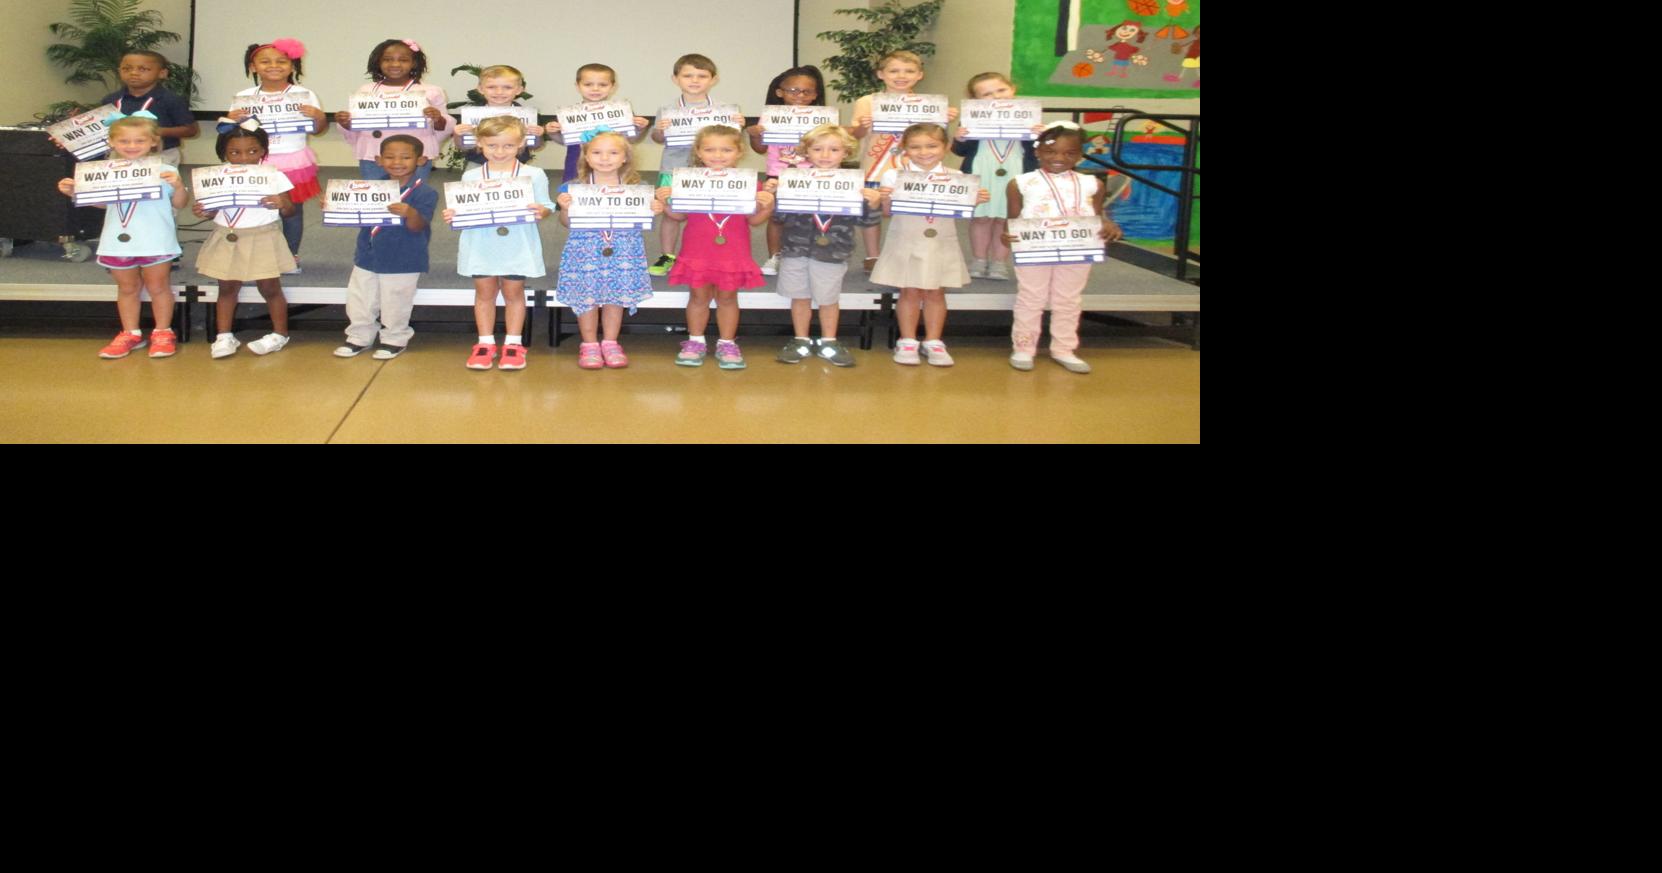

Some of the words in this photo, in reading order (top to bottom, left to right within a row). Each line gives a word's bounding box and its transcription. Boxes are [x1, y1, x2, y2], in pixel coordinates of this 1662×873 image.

[241, 105, 265, 115] WAY
[267, 104, 281, 113] TO
[285, 103, 303, 112] GO!
[358, 101, 380, 109] WAY
[385, 101, 397, 109] TO
[400, 100, 418, 109] GO!
[880, 104, 902, 113] WAY
[906, 104, 919, 113] TO
[922, 104, 940, 113] GO!
[566, 113, 588, 124] WAY
[591, 111, 604, 121] TO
[607, 109, 624, 119] GO!
[771, 115, 793, 124] WAY
[797, 116, 810, 125] TO
[812, 116, 831, 125] GO!
[970, 110, 993, 119] WAY
[997, 110, 1010, 119] TO
[1014, 110, 1033, 119] GO!
[671, 117, 693, 126] WAY
[63, 127, 86, 141] WAY
[86, 122, 101, 133] TO
[84, 171, 109, 182] WAY
[114, 170, 128, 180] TO
[132, 168, 152, 178] GO!
[201, 177, 225, 188] WAY
[230, 176, 244, 185] TO
[248, 176, 269, 185] GO!
[681, 179, 705, 189] WAY
[710, 180, 724, 189] TO
[728, 180, 747, 190] GO!
[787, 180, 812, 189] WAY
[816, 180, 831, 189] TO
[834, 180, 855, 191] GO!
[903, 182, 929, 192] WAY
[931, 183, 946, 193] TO
[949, 185, 969, 195] GO!
[331, 192, 351, 202] WAY
[354, 192, 368, 202] TO
[371, 192, 391, 202] GO!
[455, 192, 481, 204] WAY
[485, 191, 500, 201] TO
[504, 189, 524, 199] GO!
[578, 196, 603, 207] WAY
[607, 196, 621, 207] TO
[625, 196, 645, 206] GO!
[1020, 229, 1047, 241] WAY
[1051, 229, 1067, 239] TO
[1071, 228, 1093, 239] GO!
